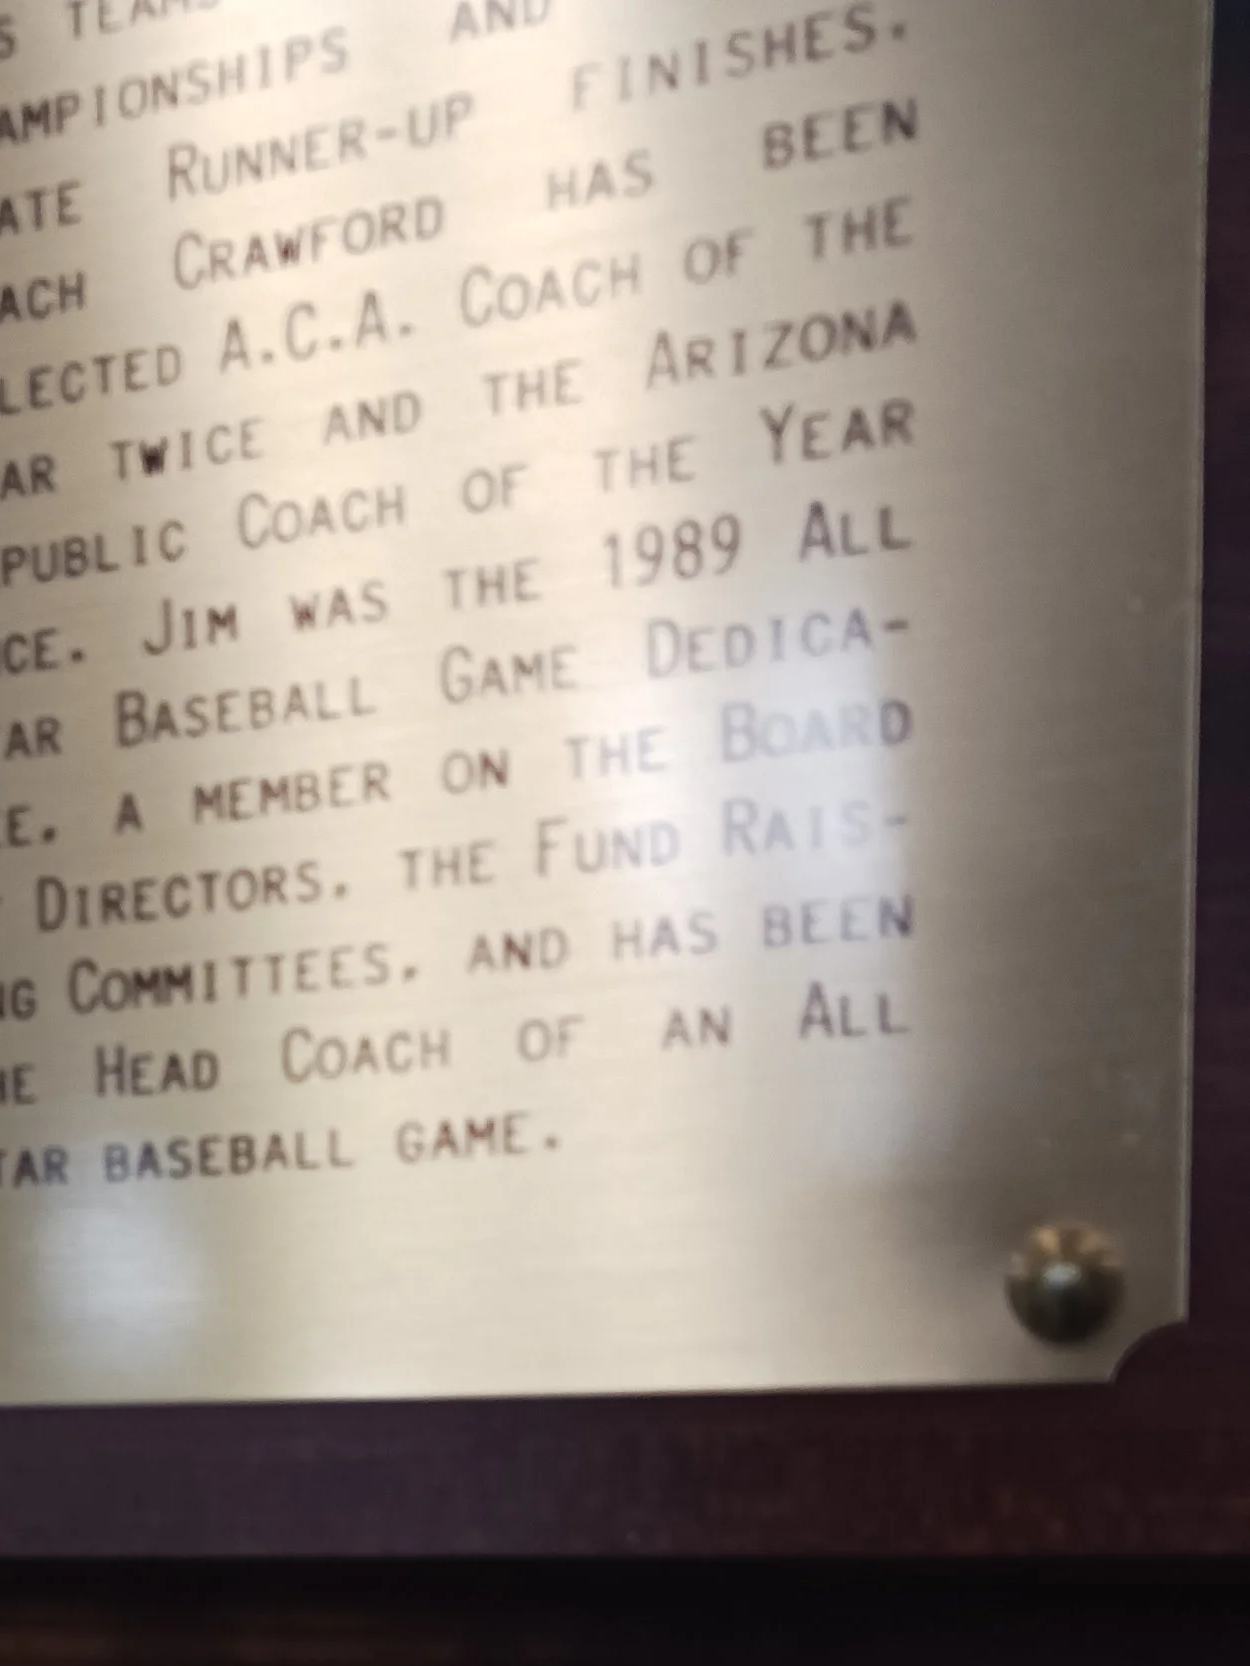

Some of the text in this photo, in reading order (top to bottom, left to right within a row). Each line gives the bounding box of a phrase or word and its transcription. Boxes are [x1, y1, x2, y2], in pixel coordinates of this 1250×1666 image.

[67, 0, 220, 40] TEA
[166, 91, 475, 202] RUNNER-UP
[571, 3, 908, 113] FINISHES.
[173, 195, 444, 292] CRAWFORD
[545, 148, 655, 211] HAS
[763, 98, 918, 171] BEEN
[220, 290, 416, 372] A.C.A.
[459, 251, 641, 329] COACH
[683, 225, 755, 286] OF
[805, 195, 914, 263] THE
[110, 417, 266, 482] TWICE
[323, 389, 424, 447] AND
[481, 357, 584, 417] THE
[647, 299, 918, 390] ARIZONA
[238, 484, 408, 551] COACH
[460, 461, 529, 515] OF
[592, 434, 697, 494] THE
[760, 398, 916, 466] YEAR
[144, 598, 239, 657] JIM
[288, 580, 391, 633] WAS
[442, 557, 541, 611] THE
[602, 512, 744, 590] 1989
[797, 498, 915, 563] ALL
[114, 676, 378, 751] BASEBALL
[438, 643, 578, 704] GAME
[646, 606, 910, 681] DEDICA-
[113, 792, 144, 835] A
[192, 760, 392, 826] MEMBER
[440, 748, 512, 796] ON
[563, 726, 668, 781] THE
[718, 698, 915, 765] BOARD
[400, 839, 496, 892] THE
[534, 815, 680, 880] FUND
[720, 796, 908, 857] RAIS-
[467, 926, 570, 975] AND
[612, 911, 719, 962] HAS
[761, 895, 914, 951] BEEN
[94, 1044, 221, 1100] HEAD
[280, 1026, 451, 1084] COACH
[516, 1015, 586, 1065] OF
[662, 1005, 733, 1052] AN
[798, 979, 912, 1041] ALL
[104, 1128, 356, 1184] BASEBALL
[396, 1111, 561, 1165] GAME.
